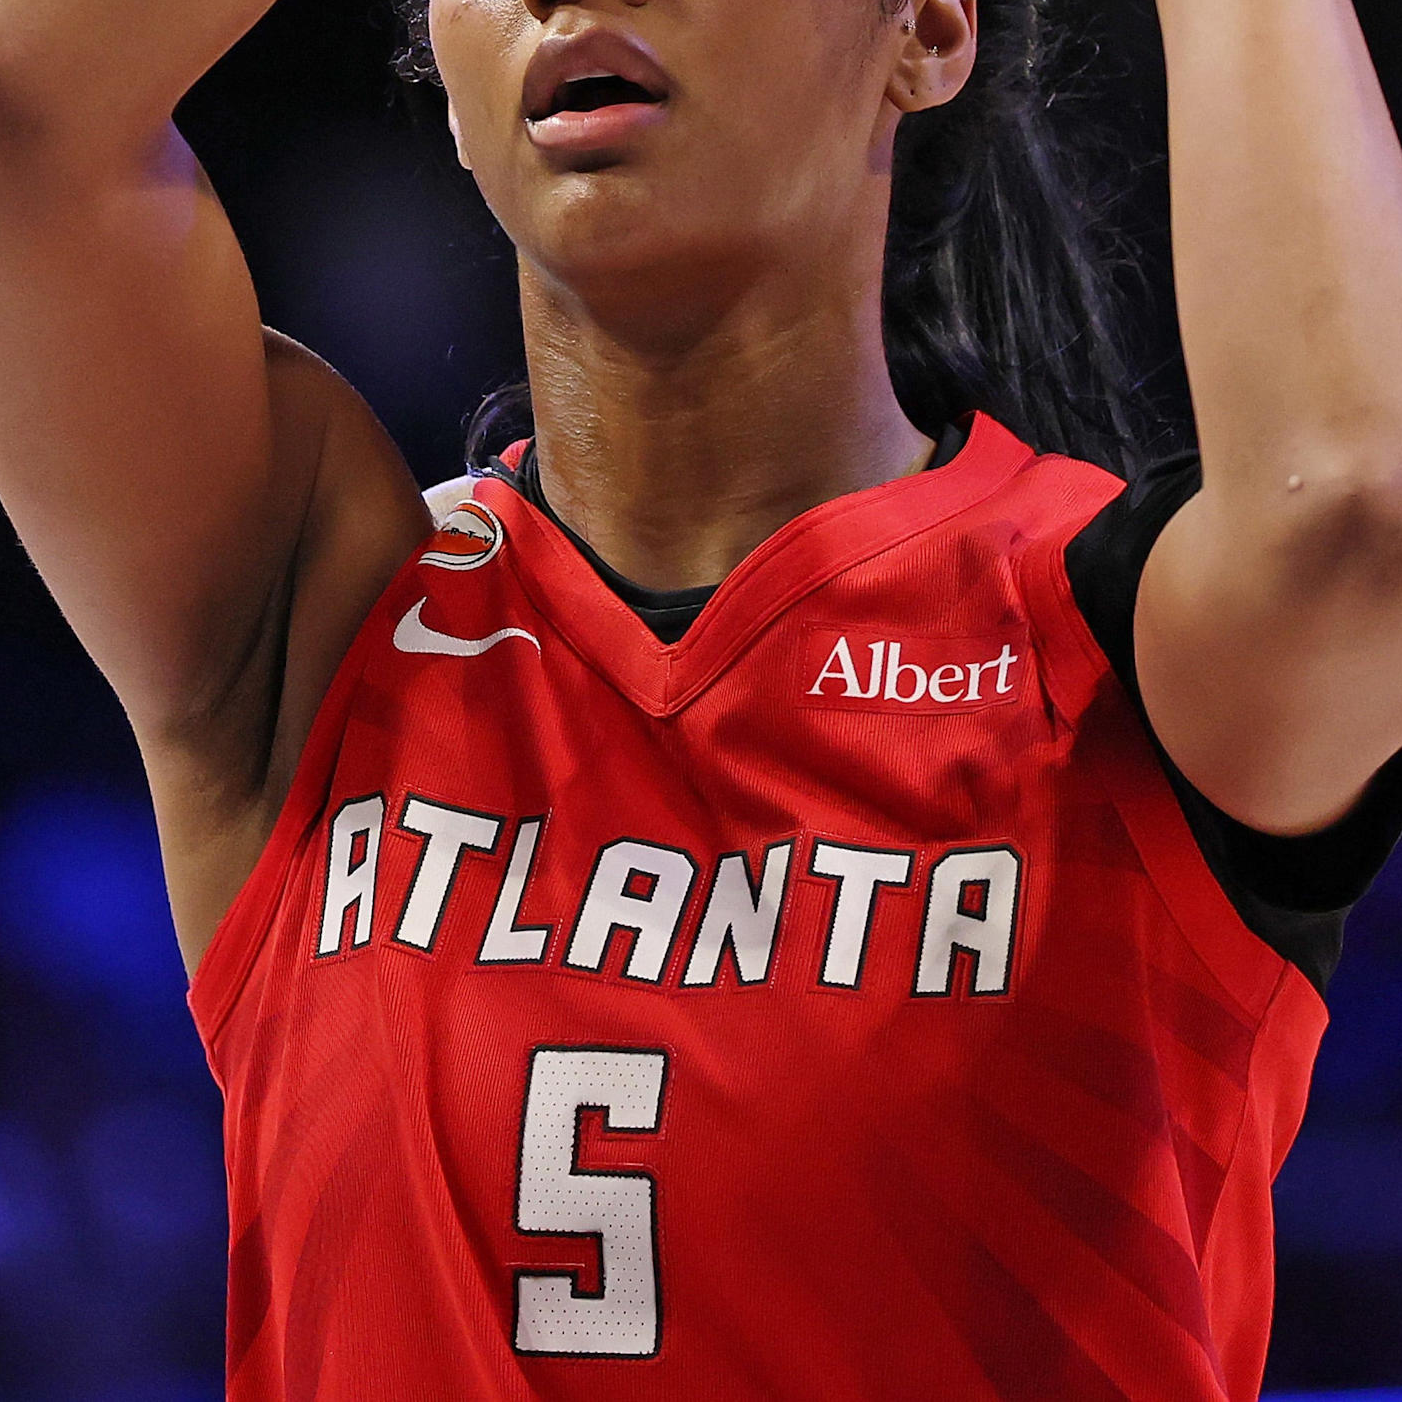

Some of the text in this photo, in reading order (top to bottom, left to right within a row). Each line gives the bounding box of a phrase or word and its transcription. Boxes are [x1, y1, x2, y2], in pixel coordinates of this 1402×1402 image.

[805, 636, 1019, 703] Albert
[313, 791, 1022, 996] ATLANTA
[512, 1045, 669, 1360] 5
